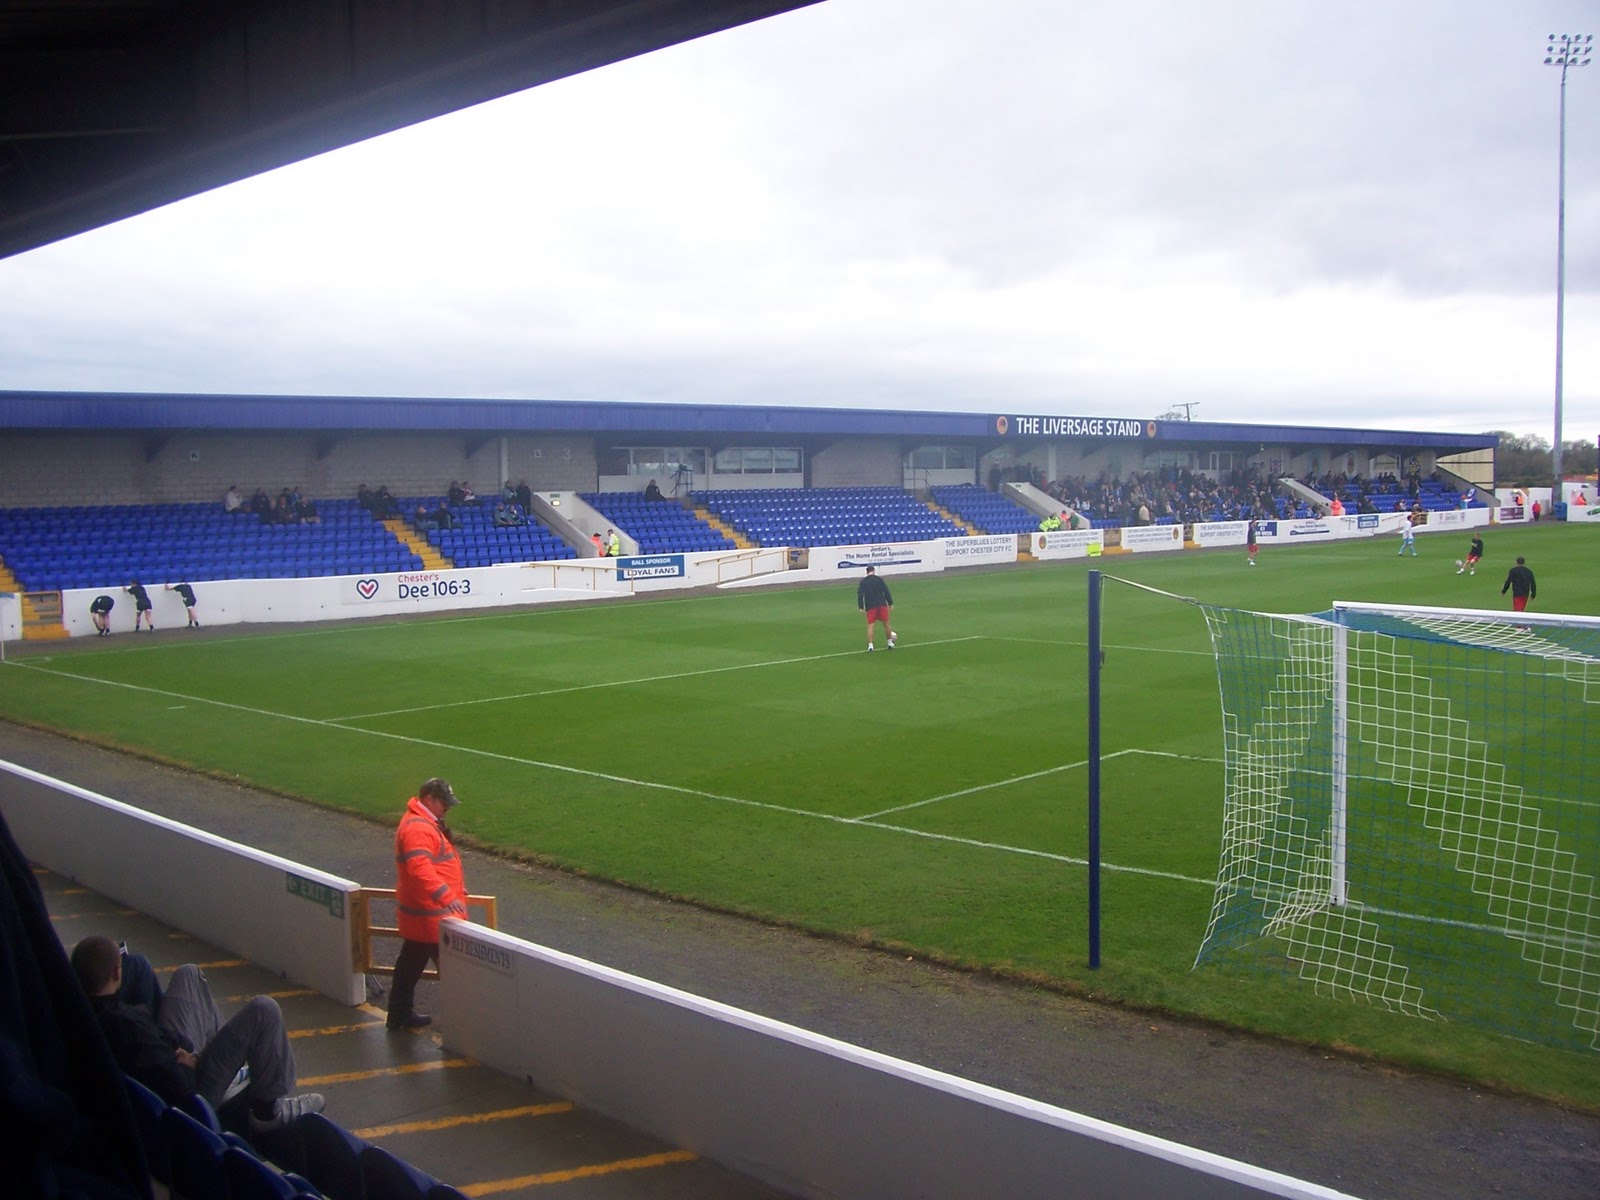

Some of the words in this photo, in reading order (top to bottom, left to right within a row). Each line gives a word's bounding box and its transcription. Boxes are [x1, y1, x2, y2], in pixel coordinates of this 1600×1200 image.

[1016, 417, 1039, 434] THE
[1043, 418, 1103, 436] LIVERSAGE
[1106, 420, 1141, 437] STAND
[945, 540, 956, 548] THE
[888, 550, 914, 558] Specialists
[945, 548, 969, 556] SUPPORT
[970, 546, 993, 554] CHESTER
[645, 557, 671, 565] SPONSOR
[627, 568, 652, 577] LOYAL
[654, 567, 675, 575] FANS
[398, 573, 439, 583] Chester's
[398, 583, 429, 599] Dee
